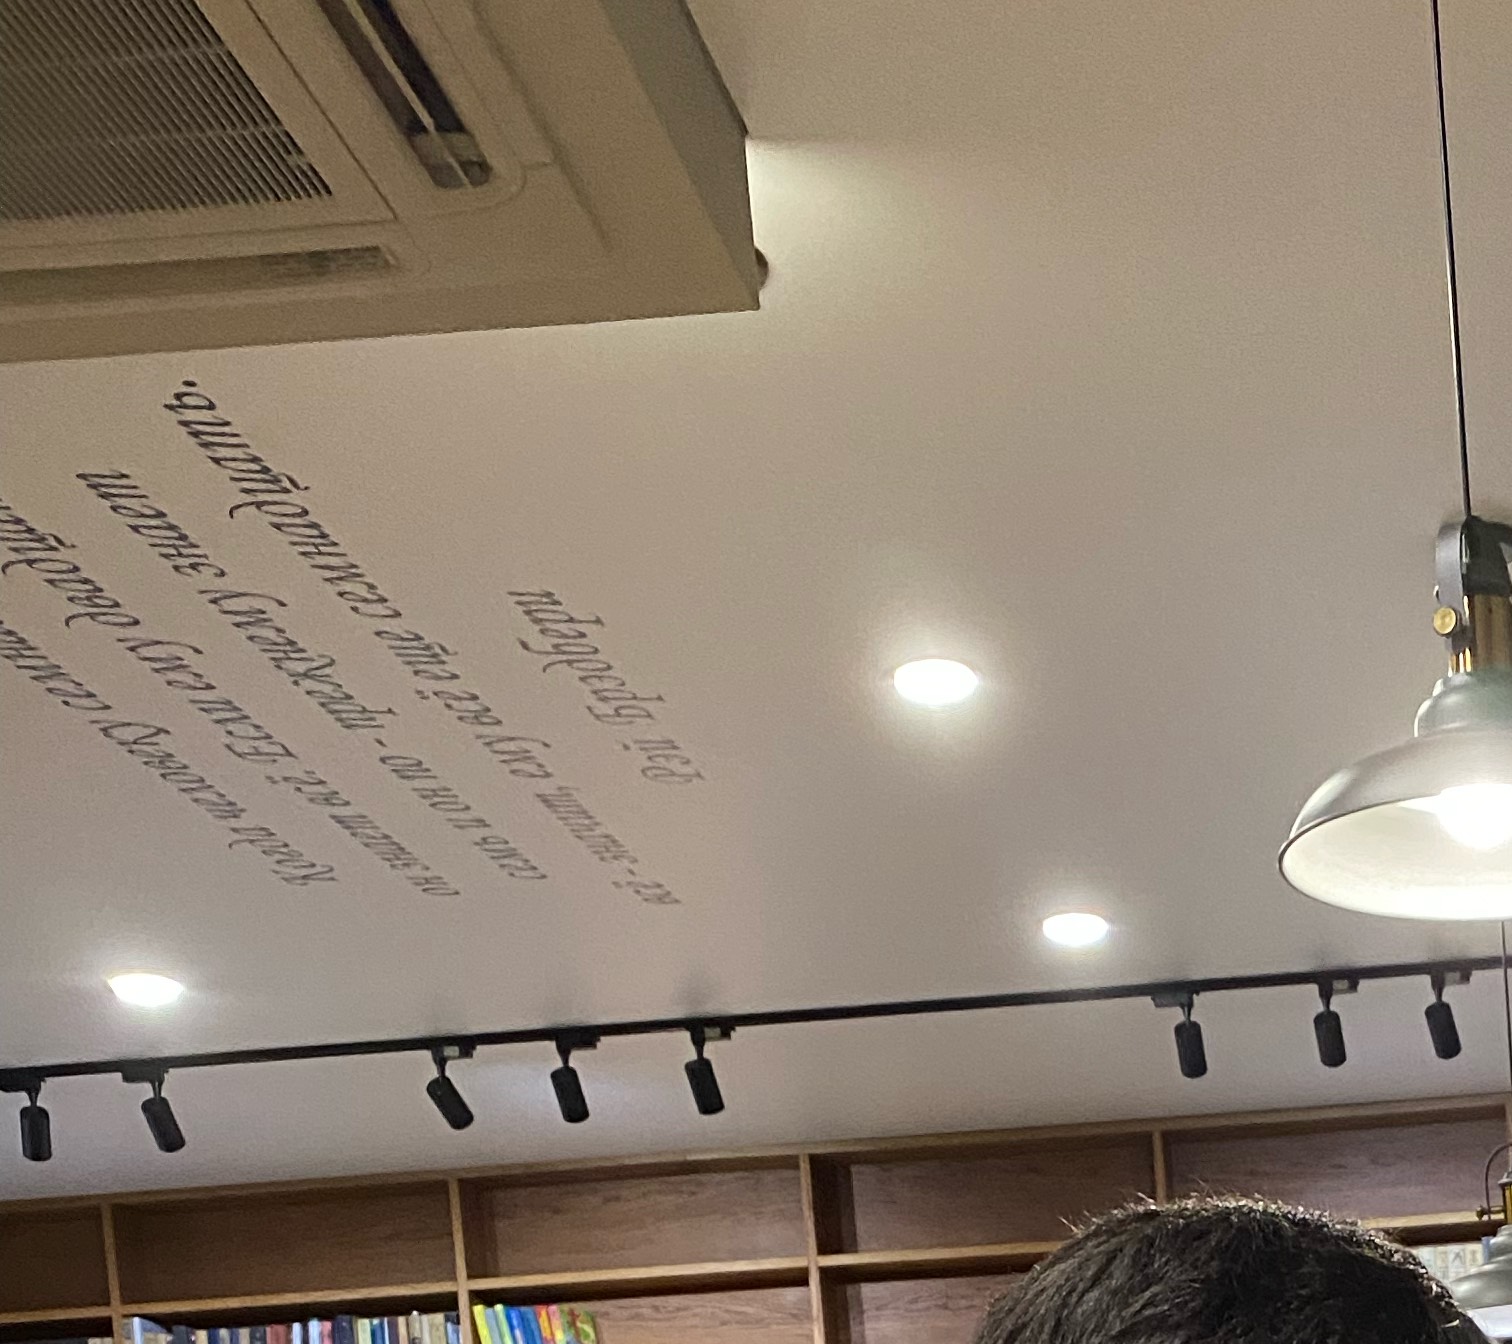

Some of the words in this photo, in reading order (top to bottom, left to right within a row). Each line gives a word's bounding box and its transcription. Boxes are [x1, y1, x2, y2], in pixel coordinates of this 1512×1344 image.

[75, 469, 226, 578] знает
[162, 379, 402, 620] семнадцать.
[115, 636, 217, 691] ему
[506, 587, 665, 726] Брэдбери
[187, 697, 298, 763] Если
[475, 733, 554, 779] ему
[88, 719, 247, 819] человеку
[621, 738, 704, 784] Рэй
[411, 785, 472, 812] он
[446, 817, 492, 830] и
[228, 826, 340, 886] Когда
[328, 813, 432, 871] знает
[473, 835, 548, 880] семь
[404, 875, 461, 896] он
